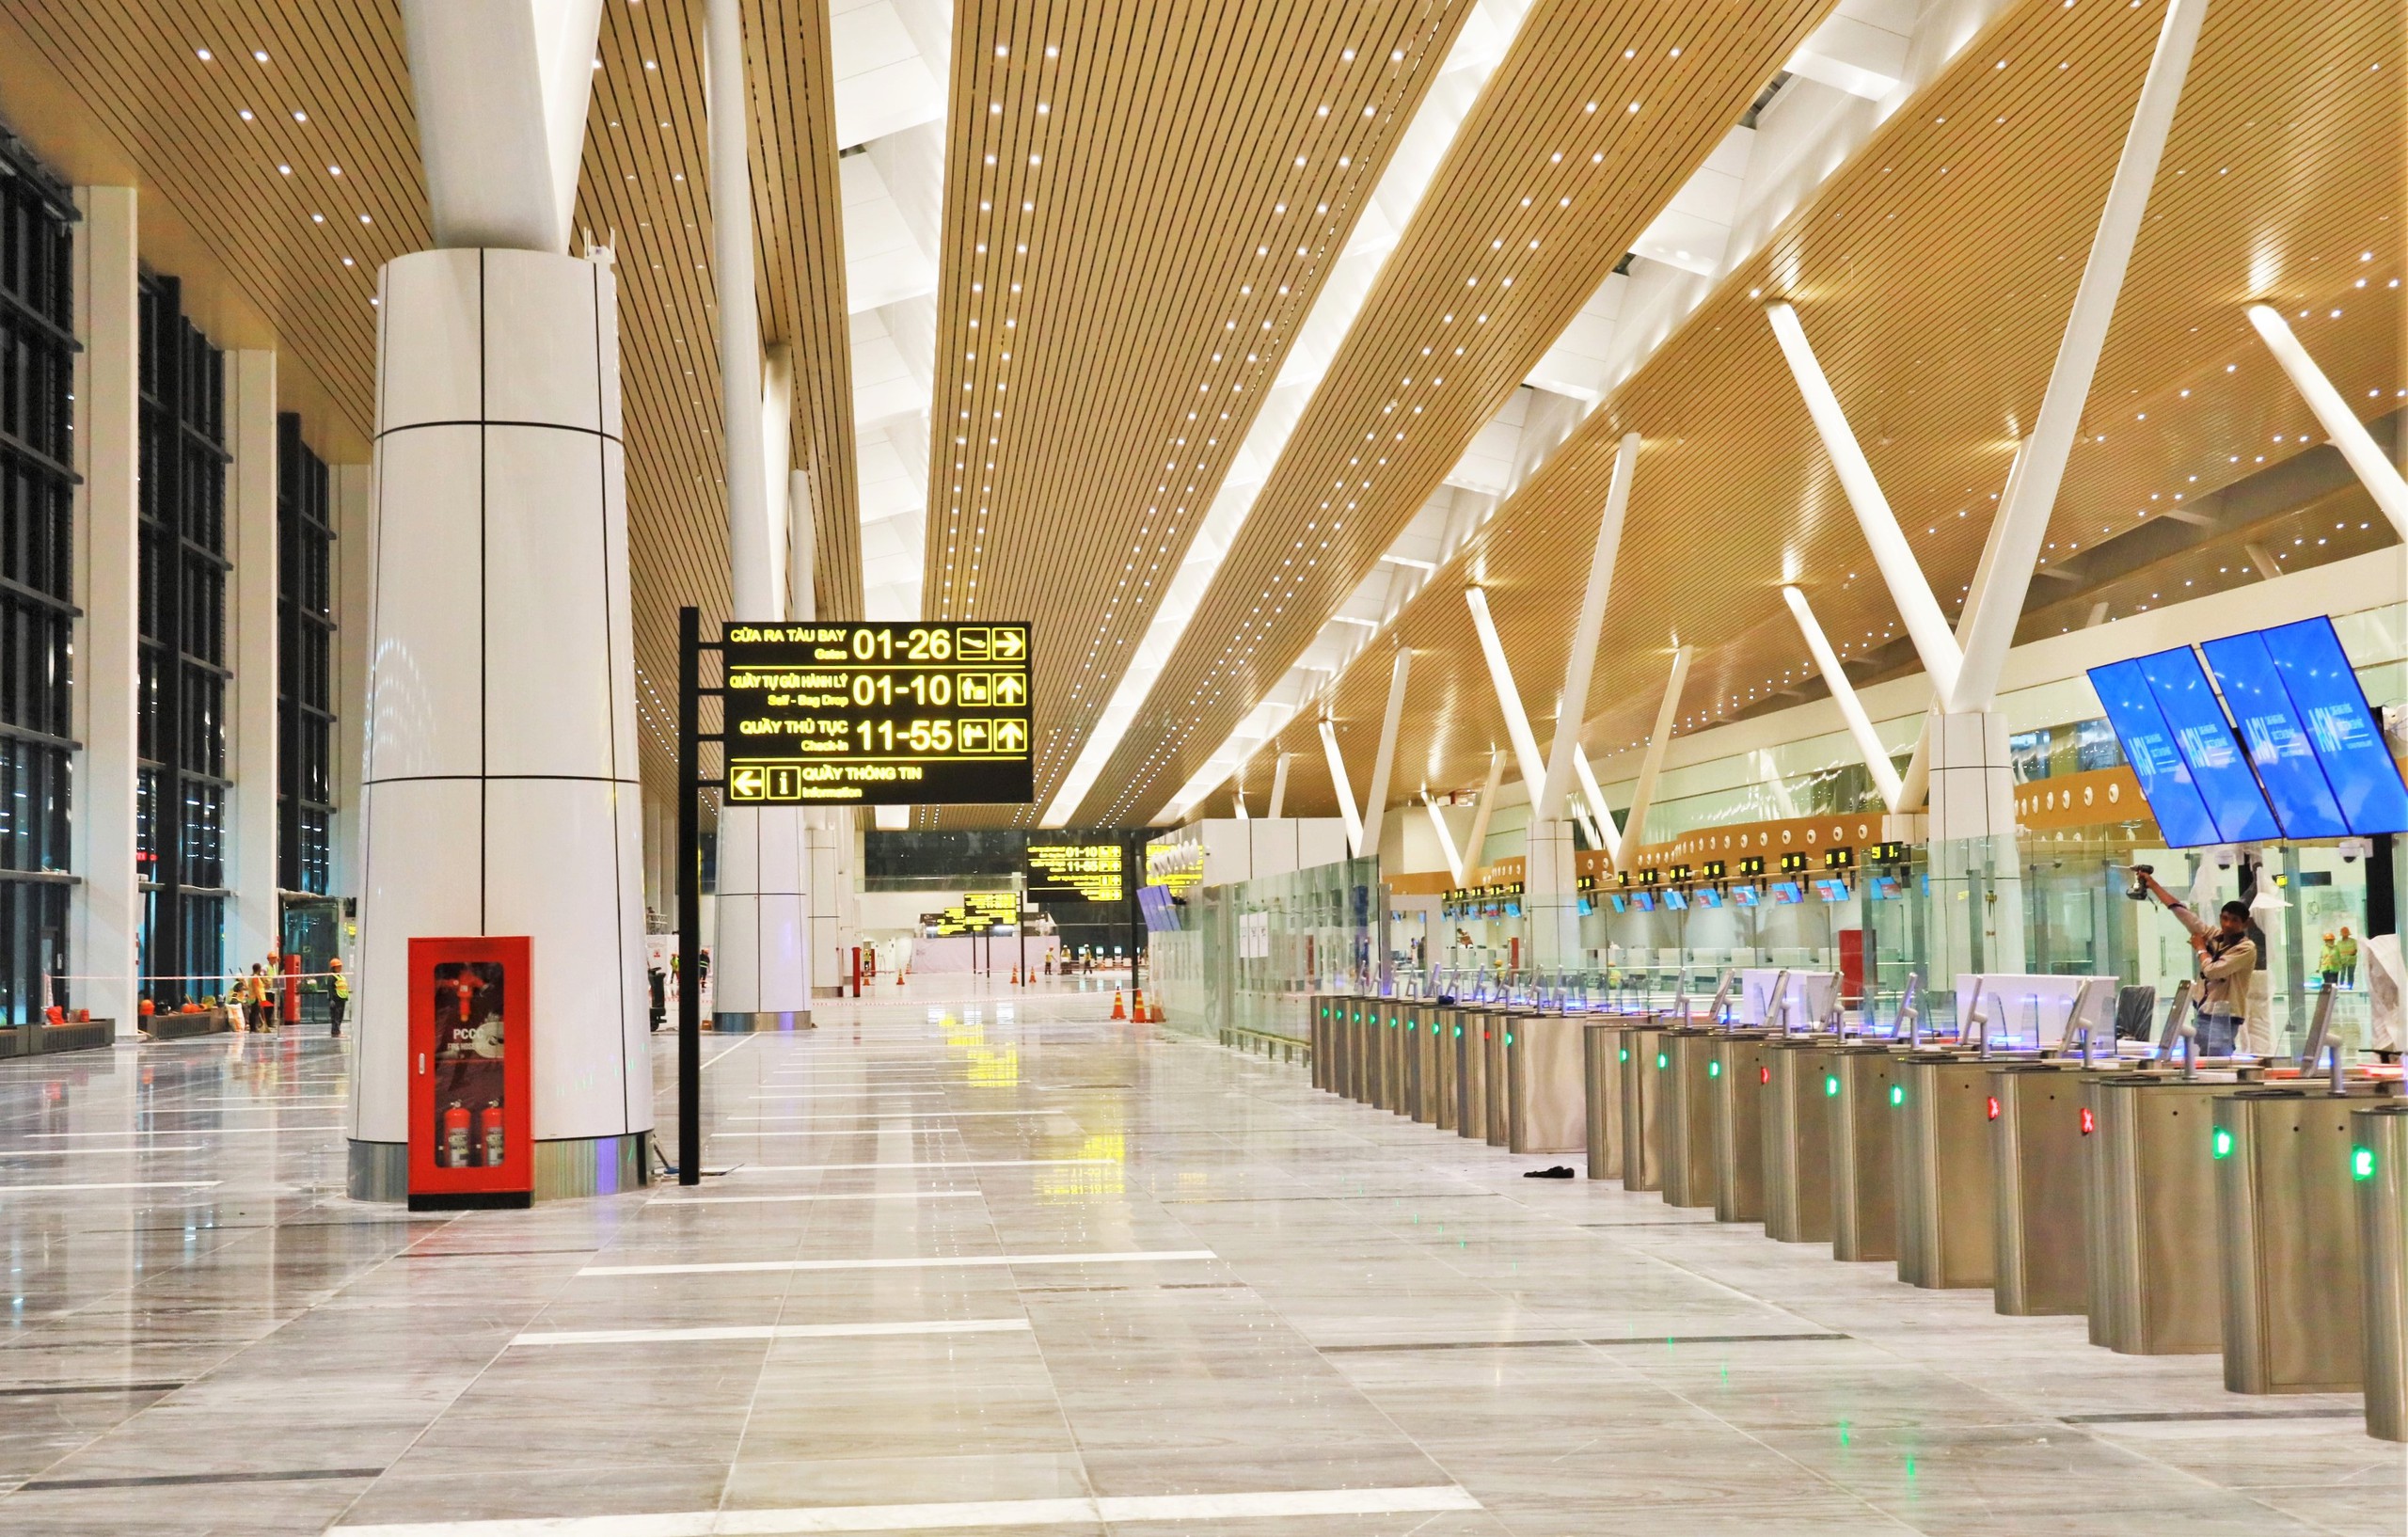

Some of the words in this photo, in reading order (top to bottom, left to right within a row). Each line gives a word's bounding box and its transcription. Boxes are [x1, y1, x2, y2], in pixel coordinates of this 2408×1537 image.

[763, 629, 785, 642] RA
[785, 627, 816, 642] TÀU
[817, 629, 847, 642] BAY
[853, 628, 952, 660] 01-26
[814, 648, 848, 660] Gates
[800, 673, 833, 689] HÀNH
[833, 673, 848, 689] LÝ
[853, 674, 952, 706] 01-10
[768, 694, 790, 706] Self
[797, 694, 821, 708] Bag
[821, 694, 849, 708] Drop
[784, 718, 816, 735] THỦ
[816, 720, 849, 737] TỤC
[856, 720, 953, 751] 11-55
[845, 765, 896, 781] THÔNG
[897, 766, 923, 780] TIN
[801, 786, 863, 799] Information
